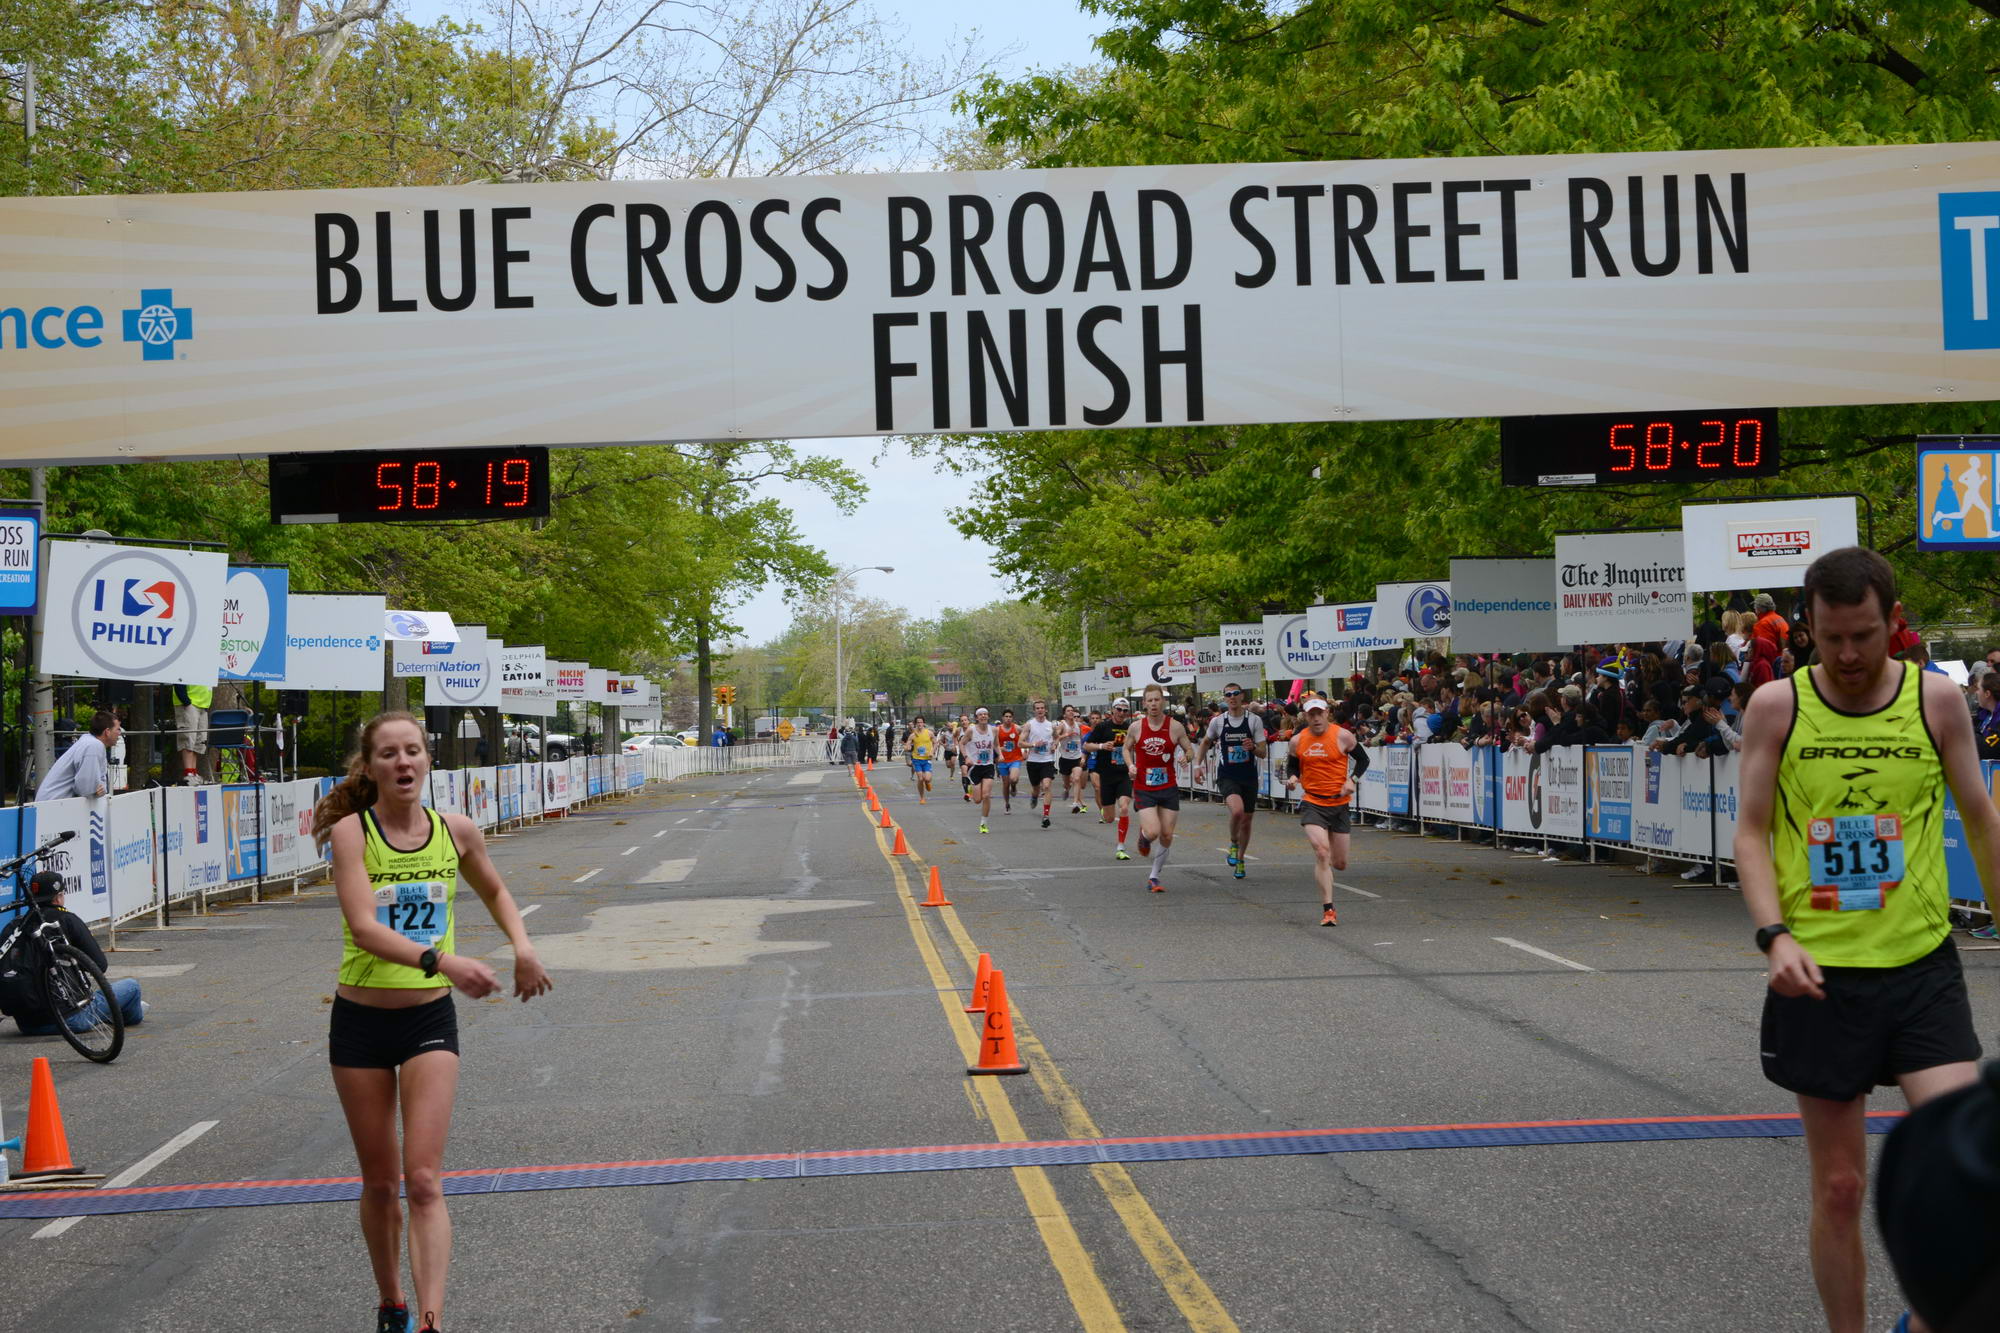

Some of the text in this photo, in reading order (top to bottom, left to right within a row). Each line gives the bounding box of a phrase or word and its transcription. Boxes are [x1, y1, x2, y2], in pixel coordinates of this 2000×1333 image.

[315, 173, 1750, 314] BLUE CROSS BROAD STREET RUN
[872, 303, 1205, 431] FINISH
[1739, 532, 1809, 548] MODELL'S
[4, 549, 29, 567] RUN
[1561, 562, 1685, 589] The Inquirer
[1453, 598, 1550, 614] Independence
[1563, 593, 1588, 609] DAILY
[1589, 592, 1613, 608] NEWS
[1564, 606, 1686, 617] INTERSTATE GENERAL MEDIA
[92, 622, 174, 646] PHILLY
[1313, 637, 1398, 651] DetermiNation
[1198, 651, 1217, 663] The
[396, 661, 481, 673] DetermiNation
[446, 678, 480, 687] PHILLY
[1799, 747, 1923, 760] BROOKS
[1506, 776, 1526, 800] GIANT
[1682, 784, 1727, 818] Independnce
[1840, 819, 1870, 830] BLUE
[1837, 830, 1875, 841] CROSS
[388, 855, 433, 864] HADDONFIELD
[1824, 839, 1890, 877] 513
[91, 860, 104, 873] NAVY
[388, 862, 420, 870] RUNNING
[92, 875, 105, 889] YARD
[400, 885, 425, 895] BLUE
[397, 894, 428, 902] CROSS
[388, 901, 436, 931] F22
